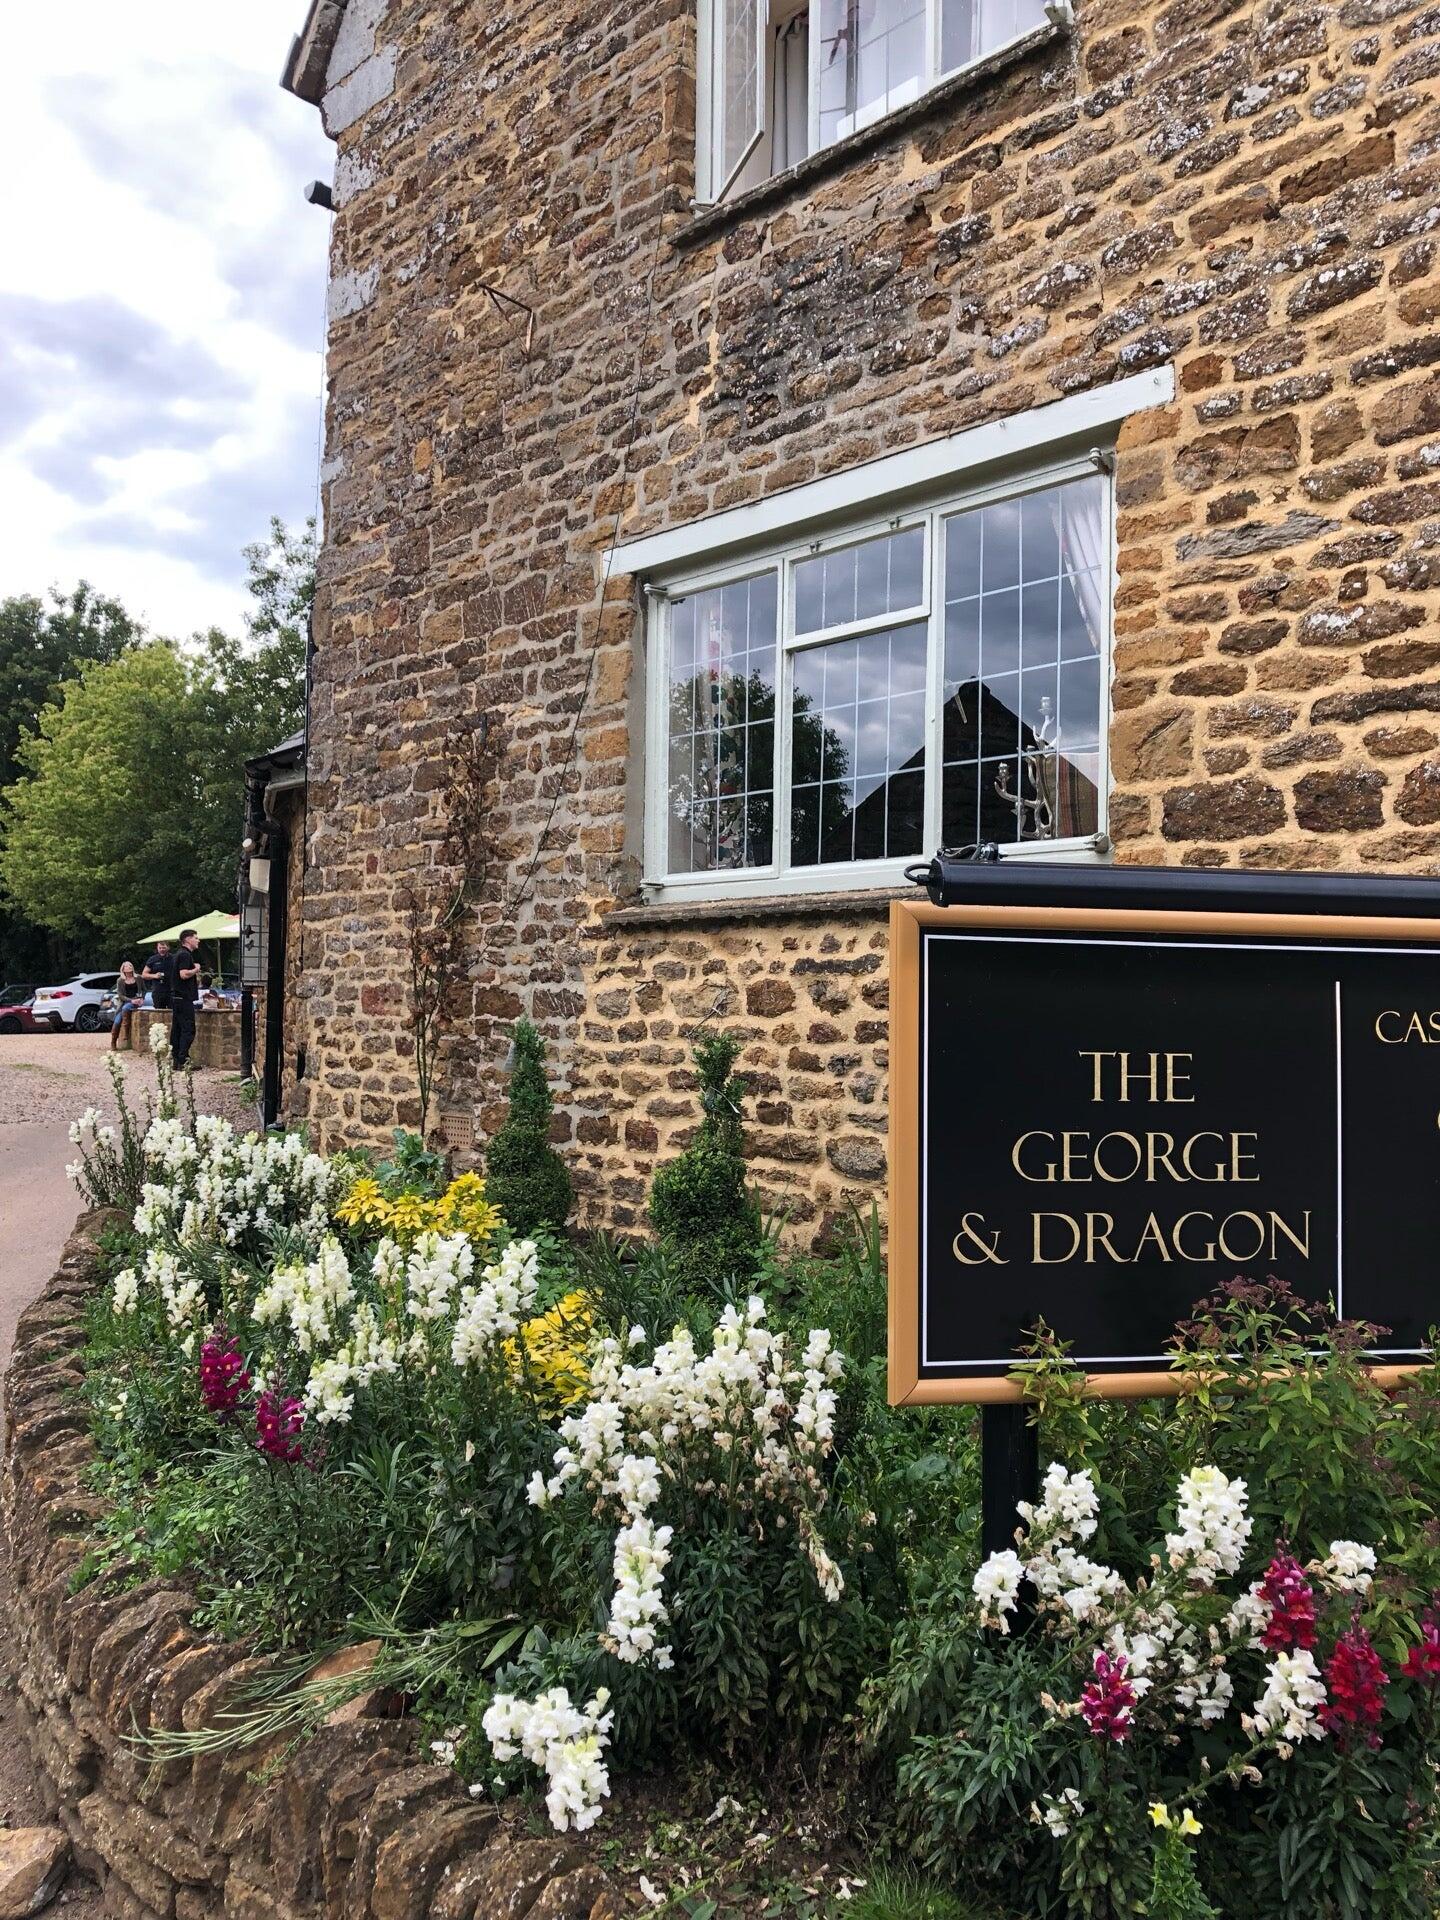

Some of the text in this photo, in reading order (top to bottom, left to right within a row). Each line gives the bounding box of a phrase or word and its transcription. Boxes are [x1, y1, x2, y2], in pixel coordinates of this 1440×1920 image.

[1375, 1010, 1440, 1044] CAS
[1078, 1050, 1195, 1103] THE
[1011, 1130, 1260, 1183] GEORGE
[952, 1210, 1312, 1265] & DRAGON
